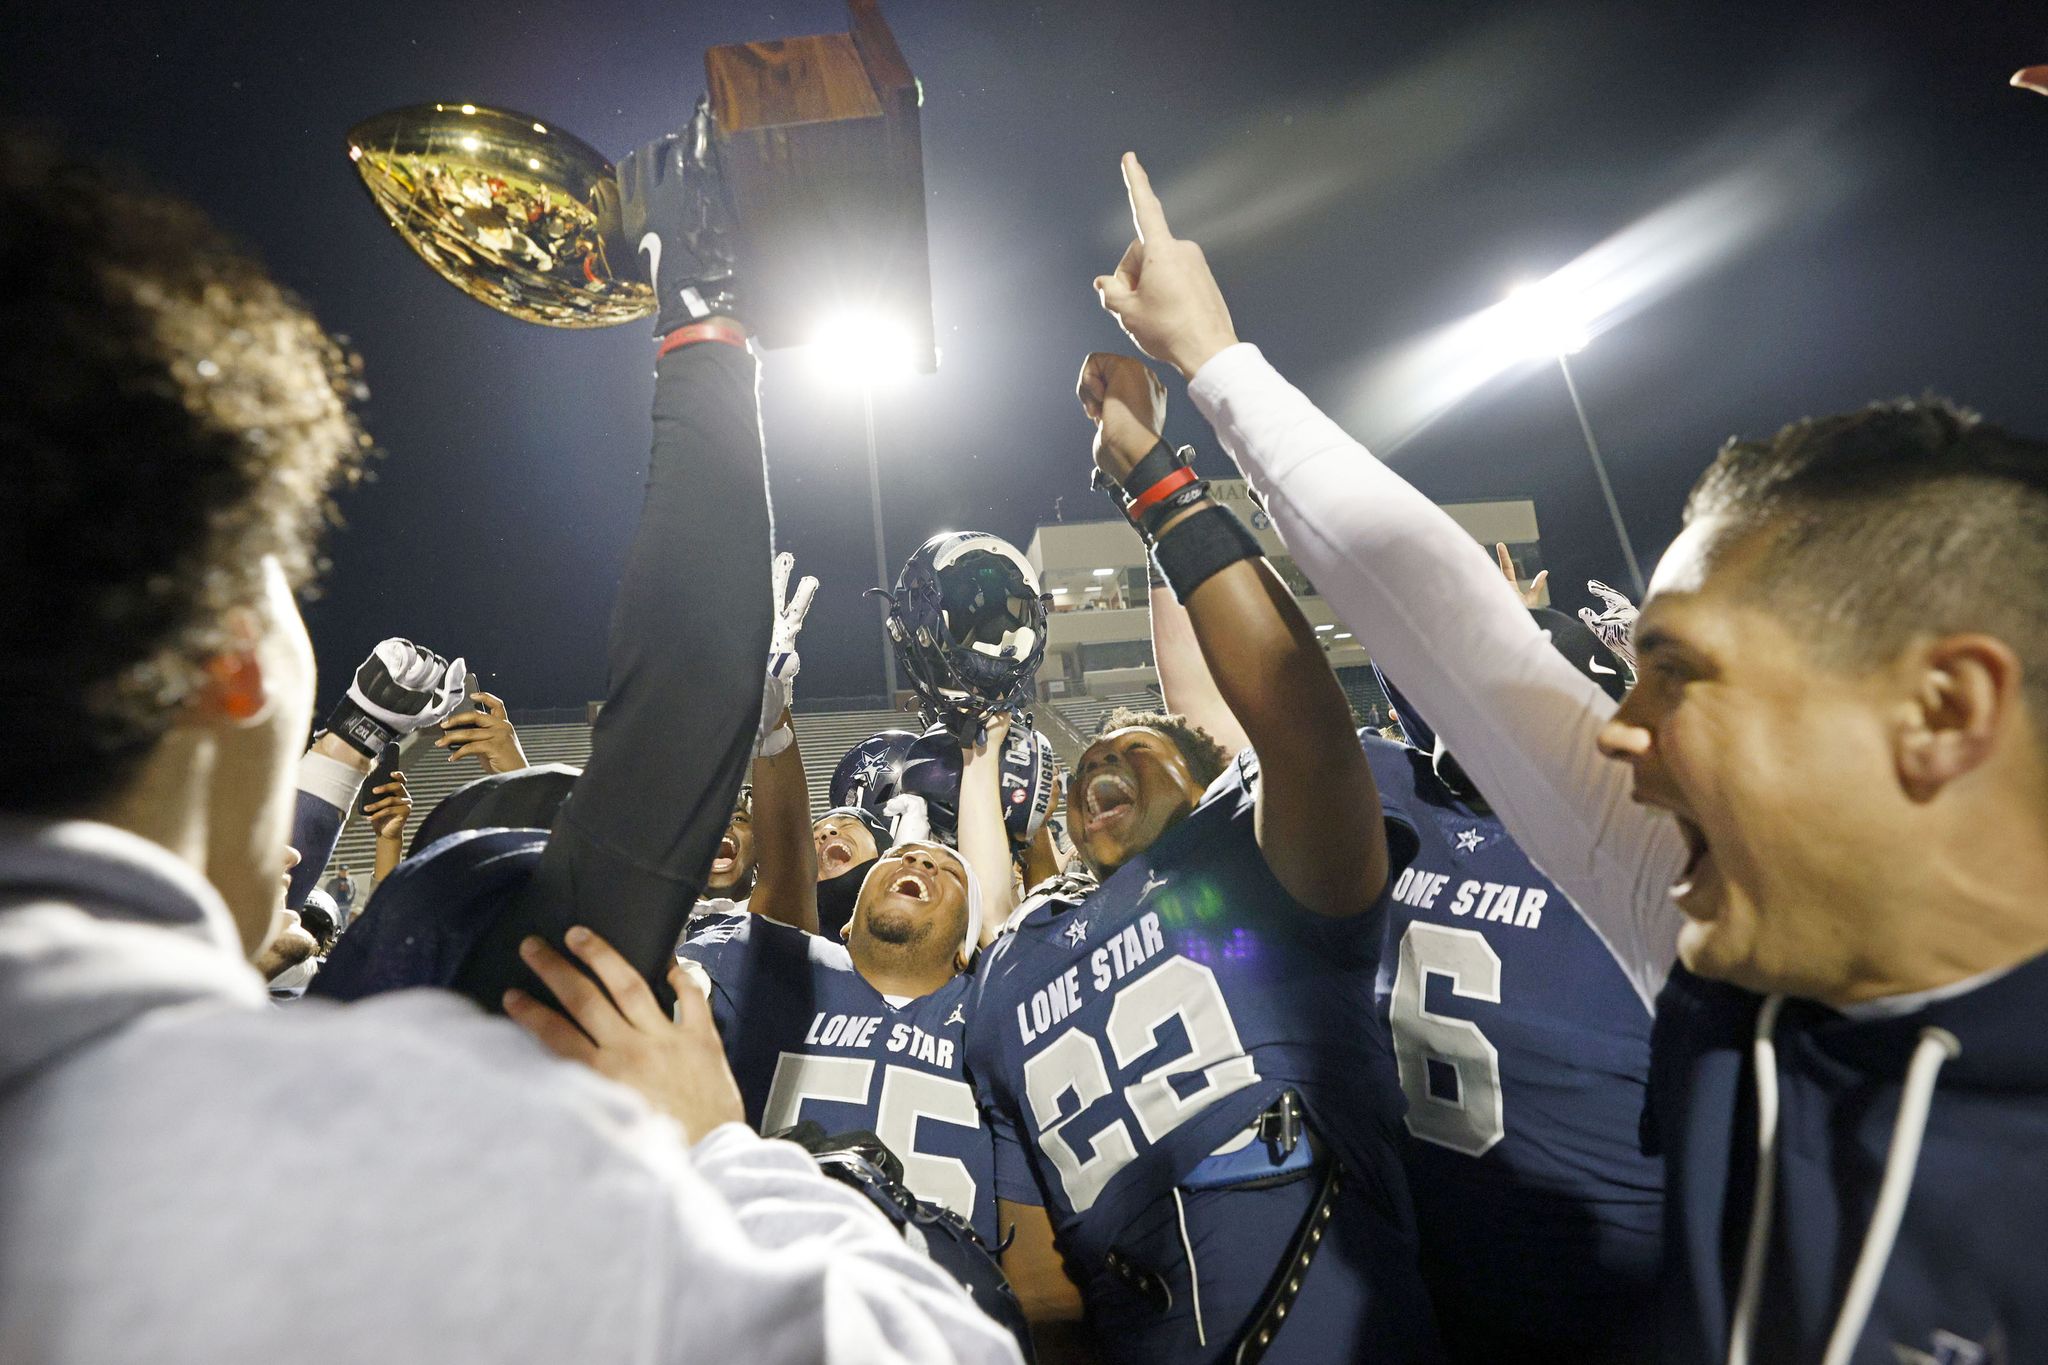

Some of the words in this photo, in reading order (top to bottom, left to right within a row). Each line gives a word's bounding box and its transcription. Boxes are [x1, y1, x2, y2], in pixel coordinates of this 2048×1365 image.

[1391, 867, 1450, 909] ONE
[1450, 880, 1548, 929] STAR
[803, 1012, 883, 1048] LONE
[886, 1023, 955, 1069] STAR
[1017, 965, 1083, 1046] LONE
[1091, 911, 1164, 992] STAR
[1389, 920, 1505, 1158] 6
[1023, 954, 1262, 1214] 22
